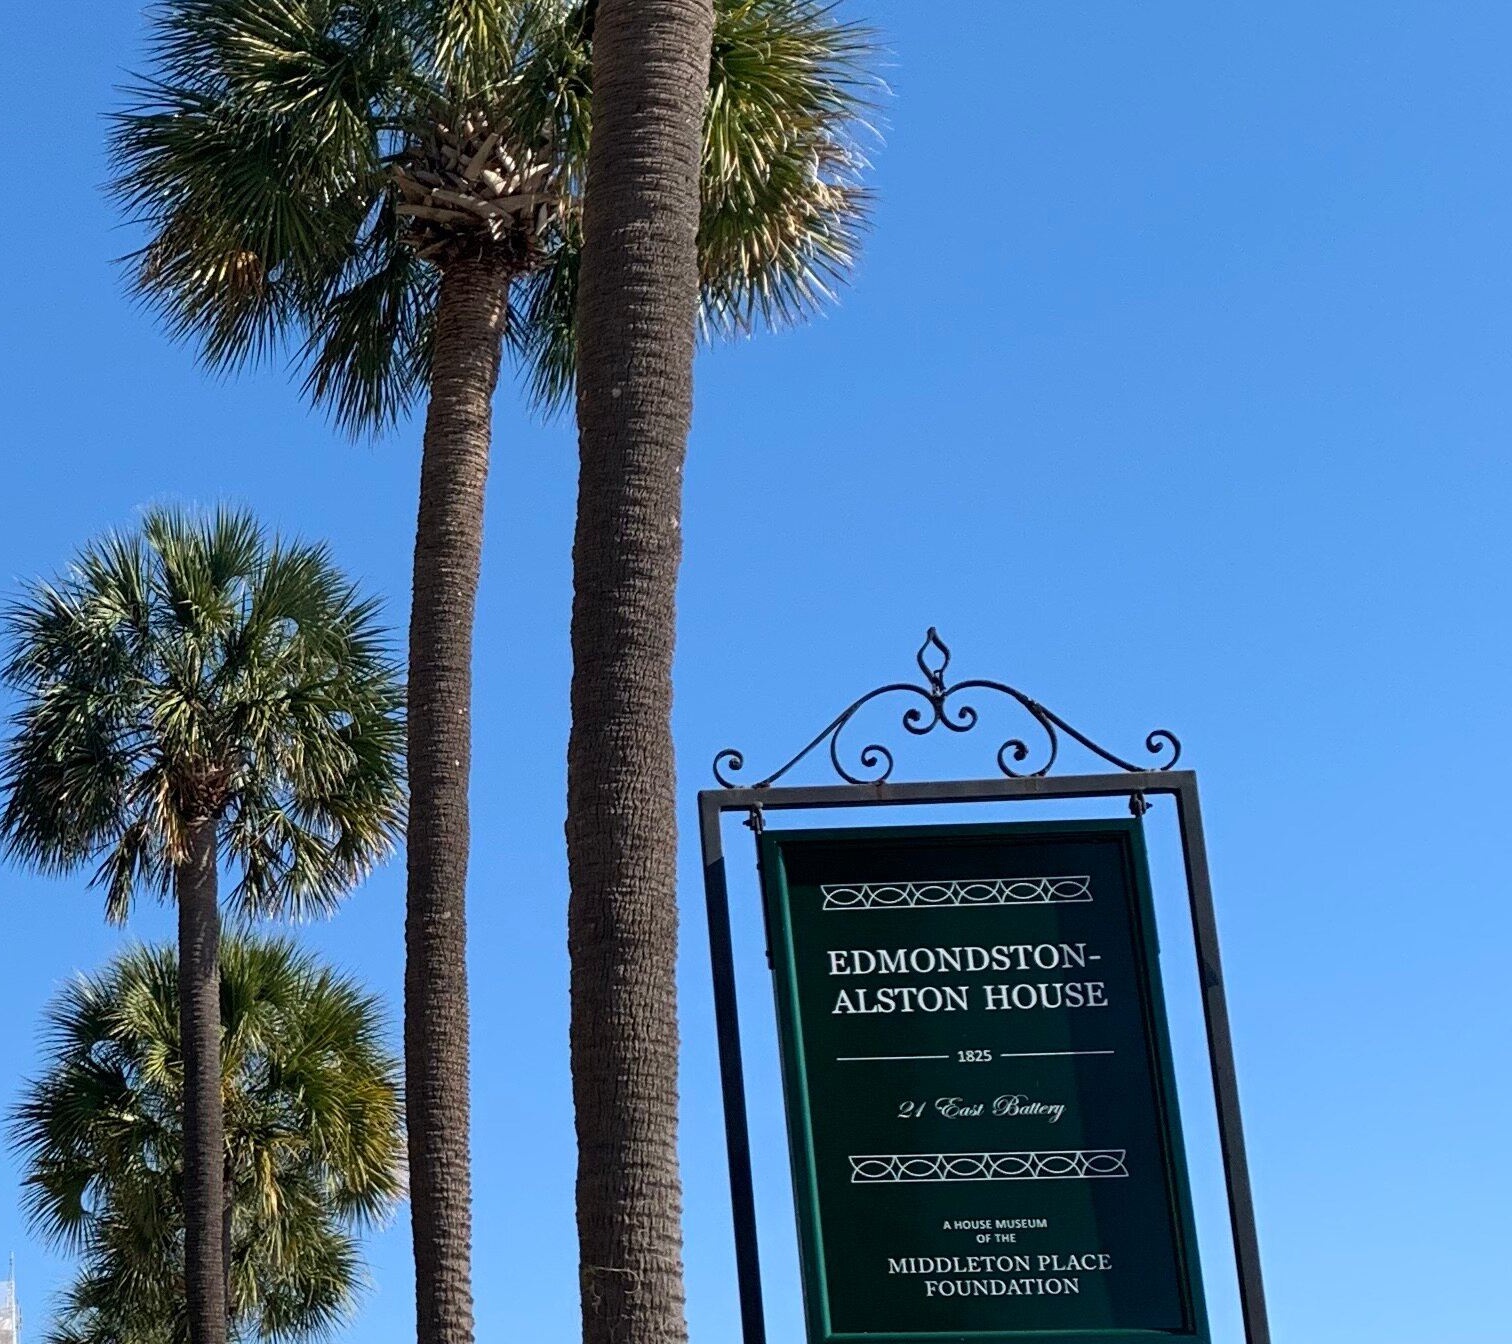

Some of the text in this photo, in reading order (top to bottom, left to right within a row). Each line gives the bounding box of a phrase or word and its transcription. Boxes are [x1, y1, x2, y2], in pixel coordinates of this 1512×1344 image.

[826, 942, 1102, 976] EDMONDSTON-
[831, 981, 1109, 1015] ALSTON HOUSE
[956, 1049, 993, 1063] 1825
[897, 1093, 1066, 1124] 21 East Battery
[942, 1218, 1048, 1230] A HOUSE MUSEUM
[975, 1232, 1017, 1244] OF THE
[887, 1253, 1113, 1275] MIDDLETON PLACE
[923, 1277, 1081, 1297] FOUNDATION
